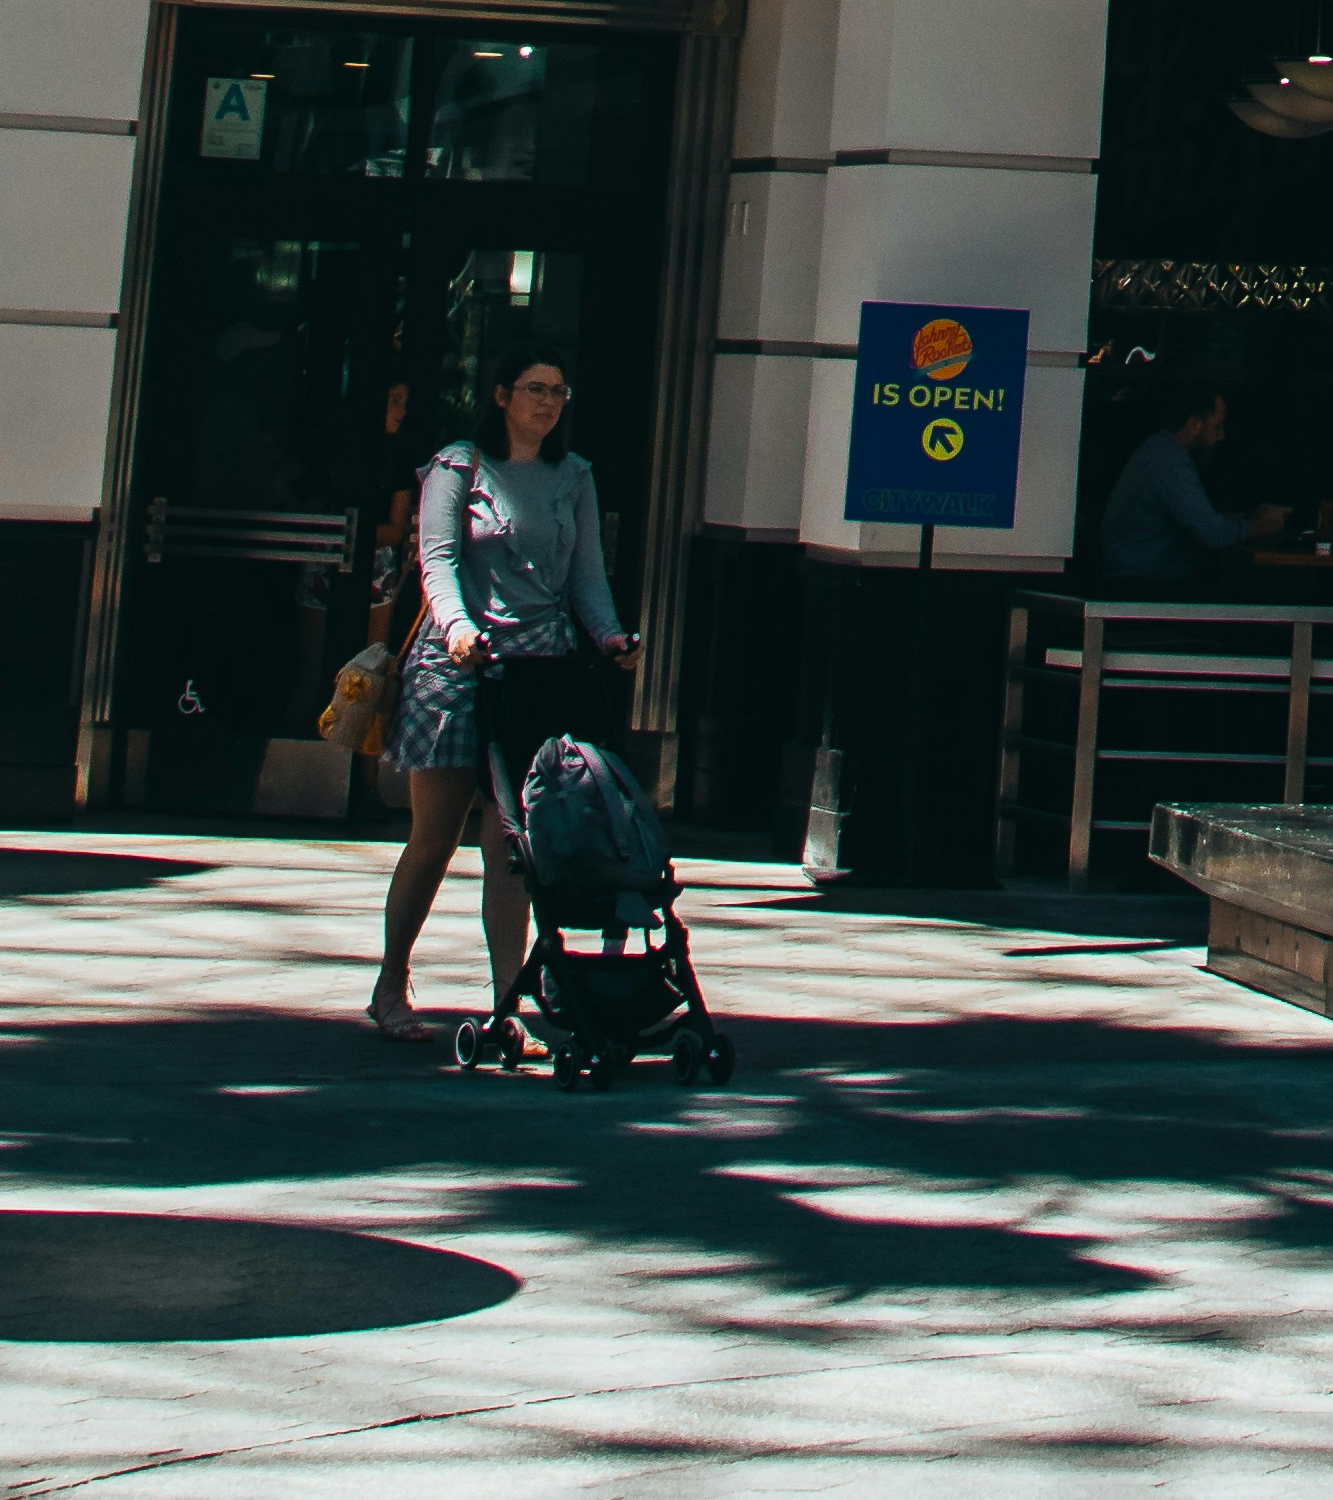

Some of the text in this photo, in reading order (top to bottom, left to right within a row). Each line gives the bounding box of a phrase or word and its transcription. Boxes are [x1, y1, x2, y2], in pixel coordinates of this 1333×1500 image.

[214, 83, 250, 122] A
[873, 383, 1005, 411] IS OPEN!
[863, 489, 994, 516] CITYWALK
